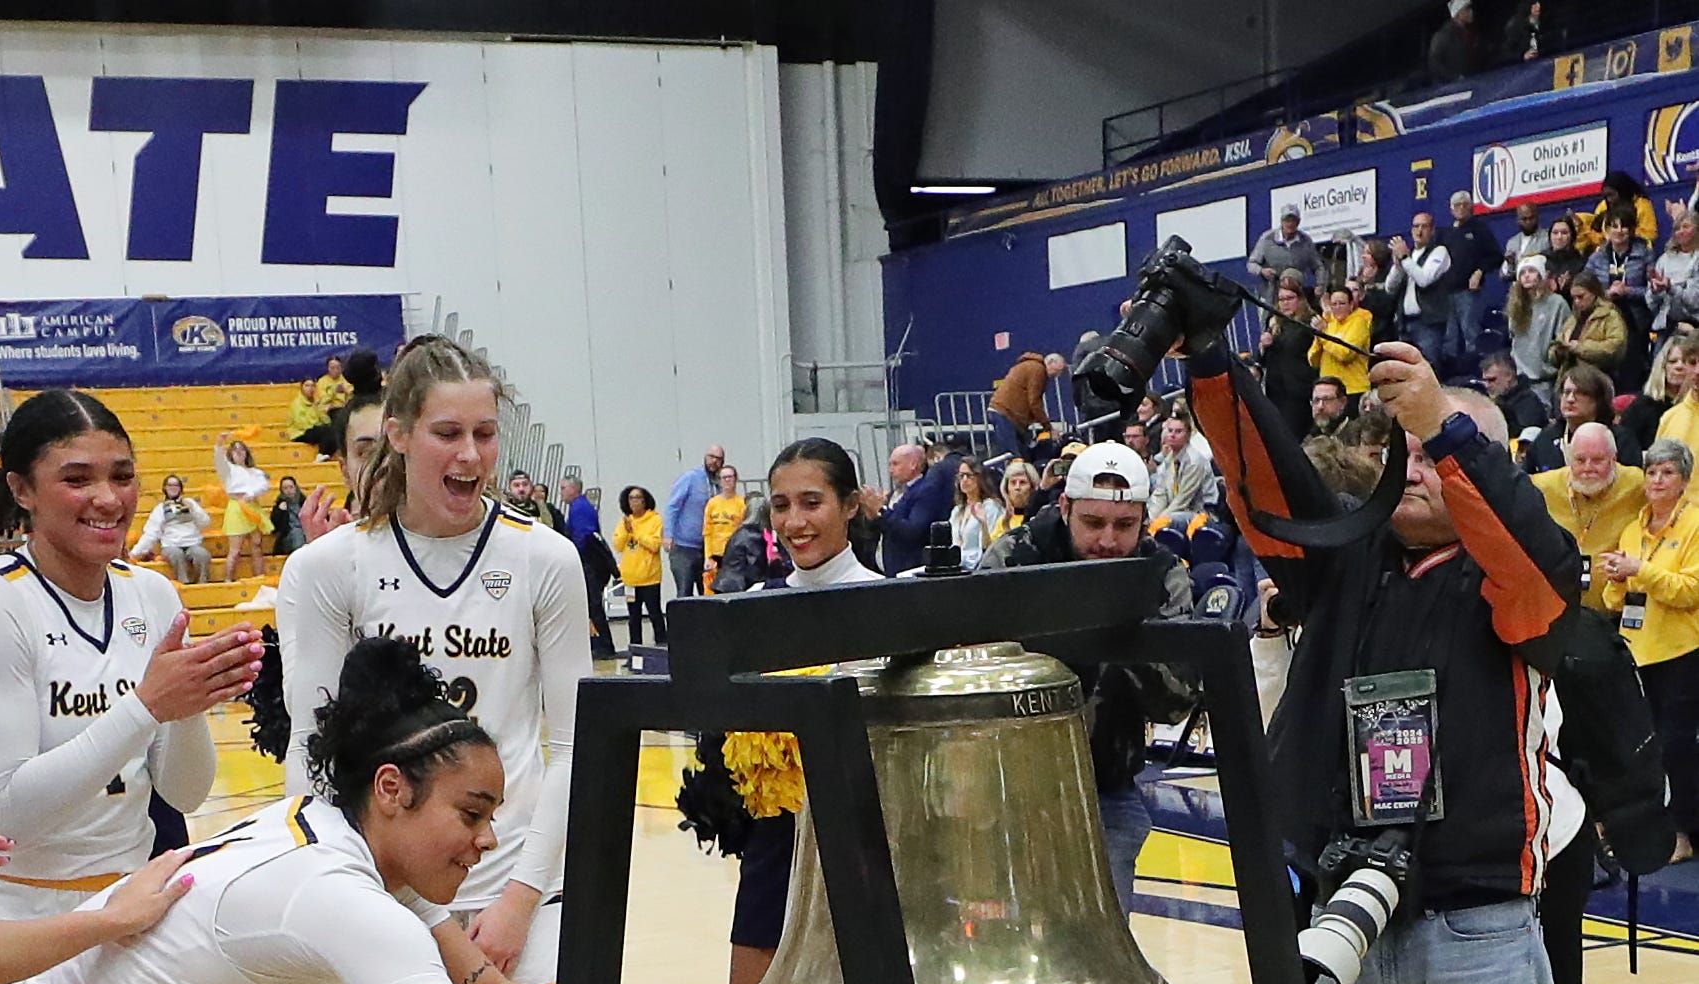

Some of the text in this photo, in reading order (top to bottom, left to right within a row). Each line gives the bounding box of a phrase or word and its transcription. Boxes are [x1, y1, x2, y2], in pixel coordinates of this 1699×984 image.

[1533, 138, 1586, 162] Ohio's #1
[1108, 165, 1139, 189] LET'S
[1141, 162, 1159, 182] GO
[1223, 138, 1252, 164] KSU.
[1521, 165, 1557, 184] Credit
[1558, 155, 1599, 178] Union!
[1303, 184, 1369, 211] Ken Ganley
[41, 313, 115, 327] AMERICAN
[228, 315, 338, 332] PROUD PARTNER OF
[41, 326, 116, 339] CAMPUS
[229, 331, 359, 348] KENT STATE ATHLETICS
[34, 344, 82, 360] students
[82, 343, 106, 358] love
[444, 624, 512, 659] State
[48, 680, 111, 718] Kent
[1384, 748, 1412, 774] M
[1385, 773, 1412, 781] MEDIA
[1373, 802, 1392, 810] MAC
